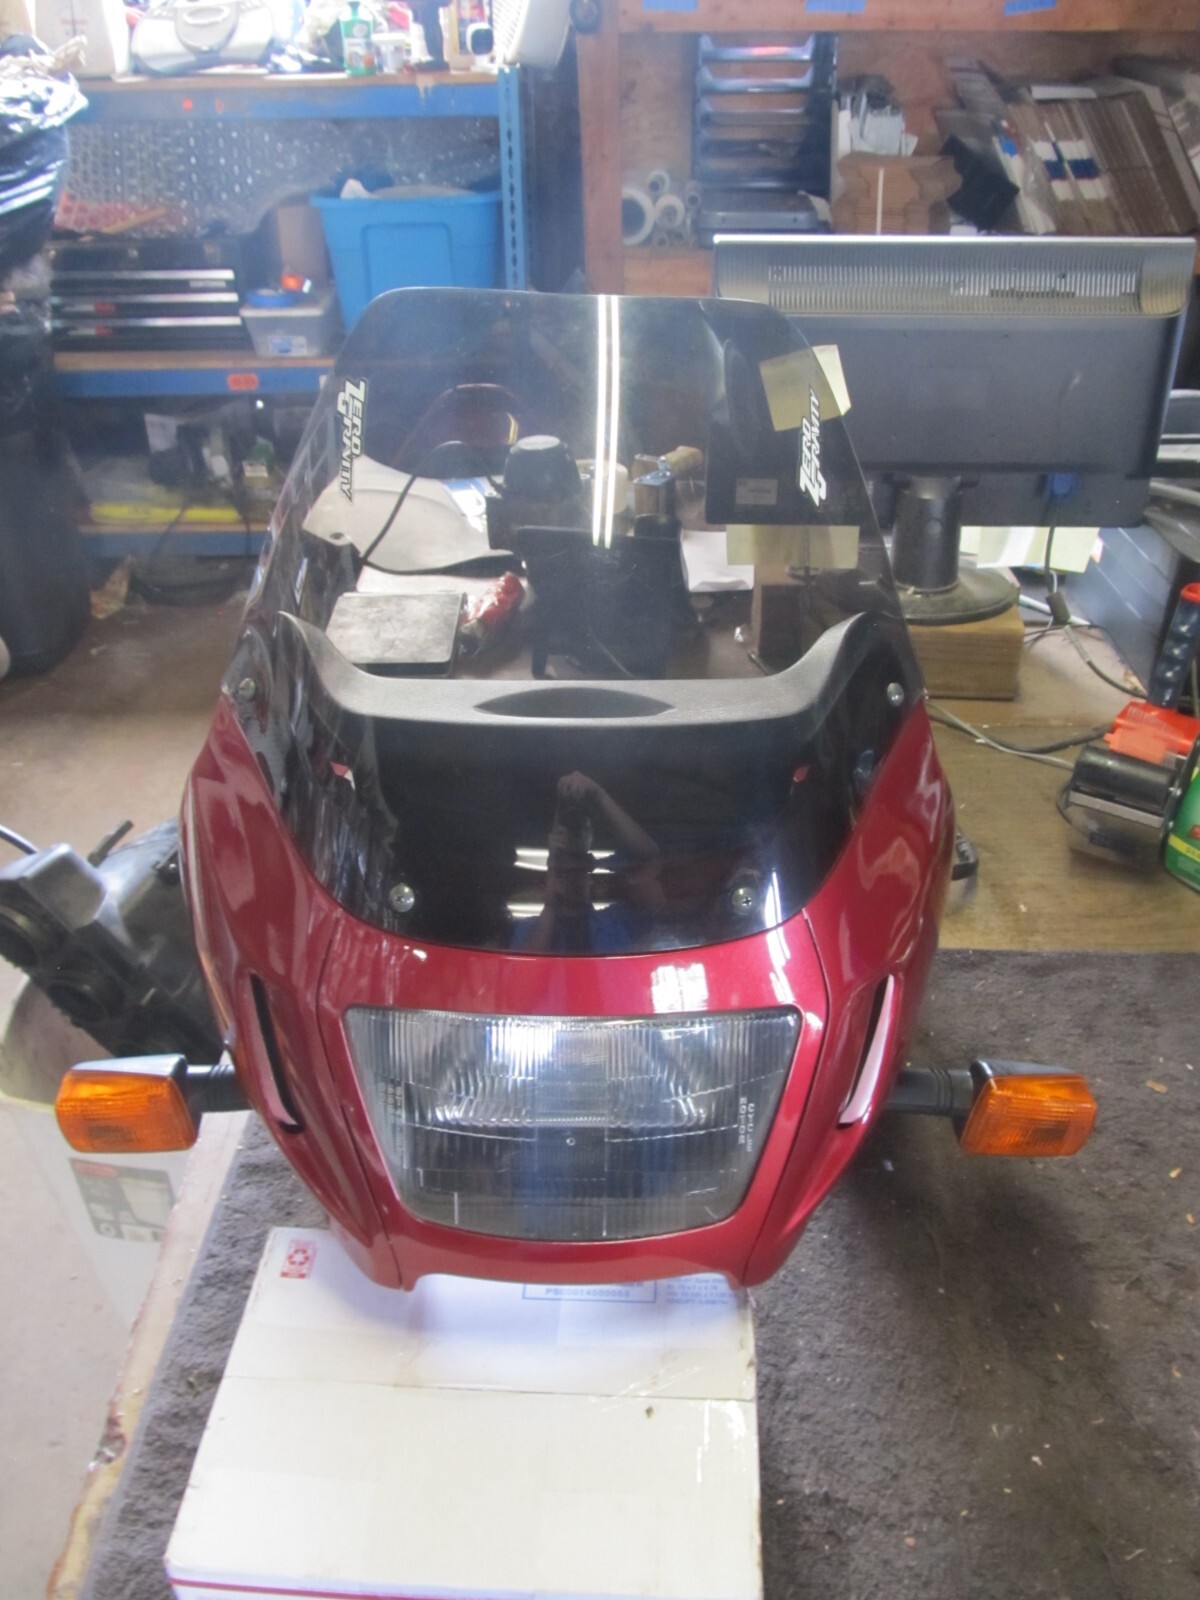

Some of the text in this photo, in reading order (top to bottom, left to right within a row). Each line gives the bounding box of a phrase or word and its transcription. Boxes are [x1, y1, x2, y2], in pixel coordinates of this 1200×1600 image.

[337, 391, 353, 502] GRAVITY
[344, 379, 366, 458] ZERO
[799, 417, 820, 507] ZERO
[809, 387, 827, 500] GRAVITY
